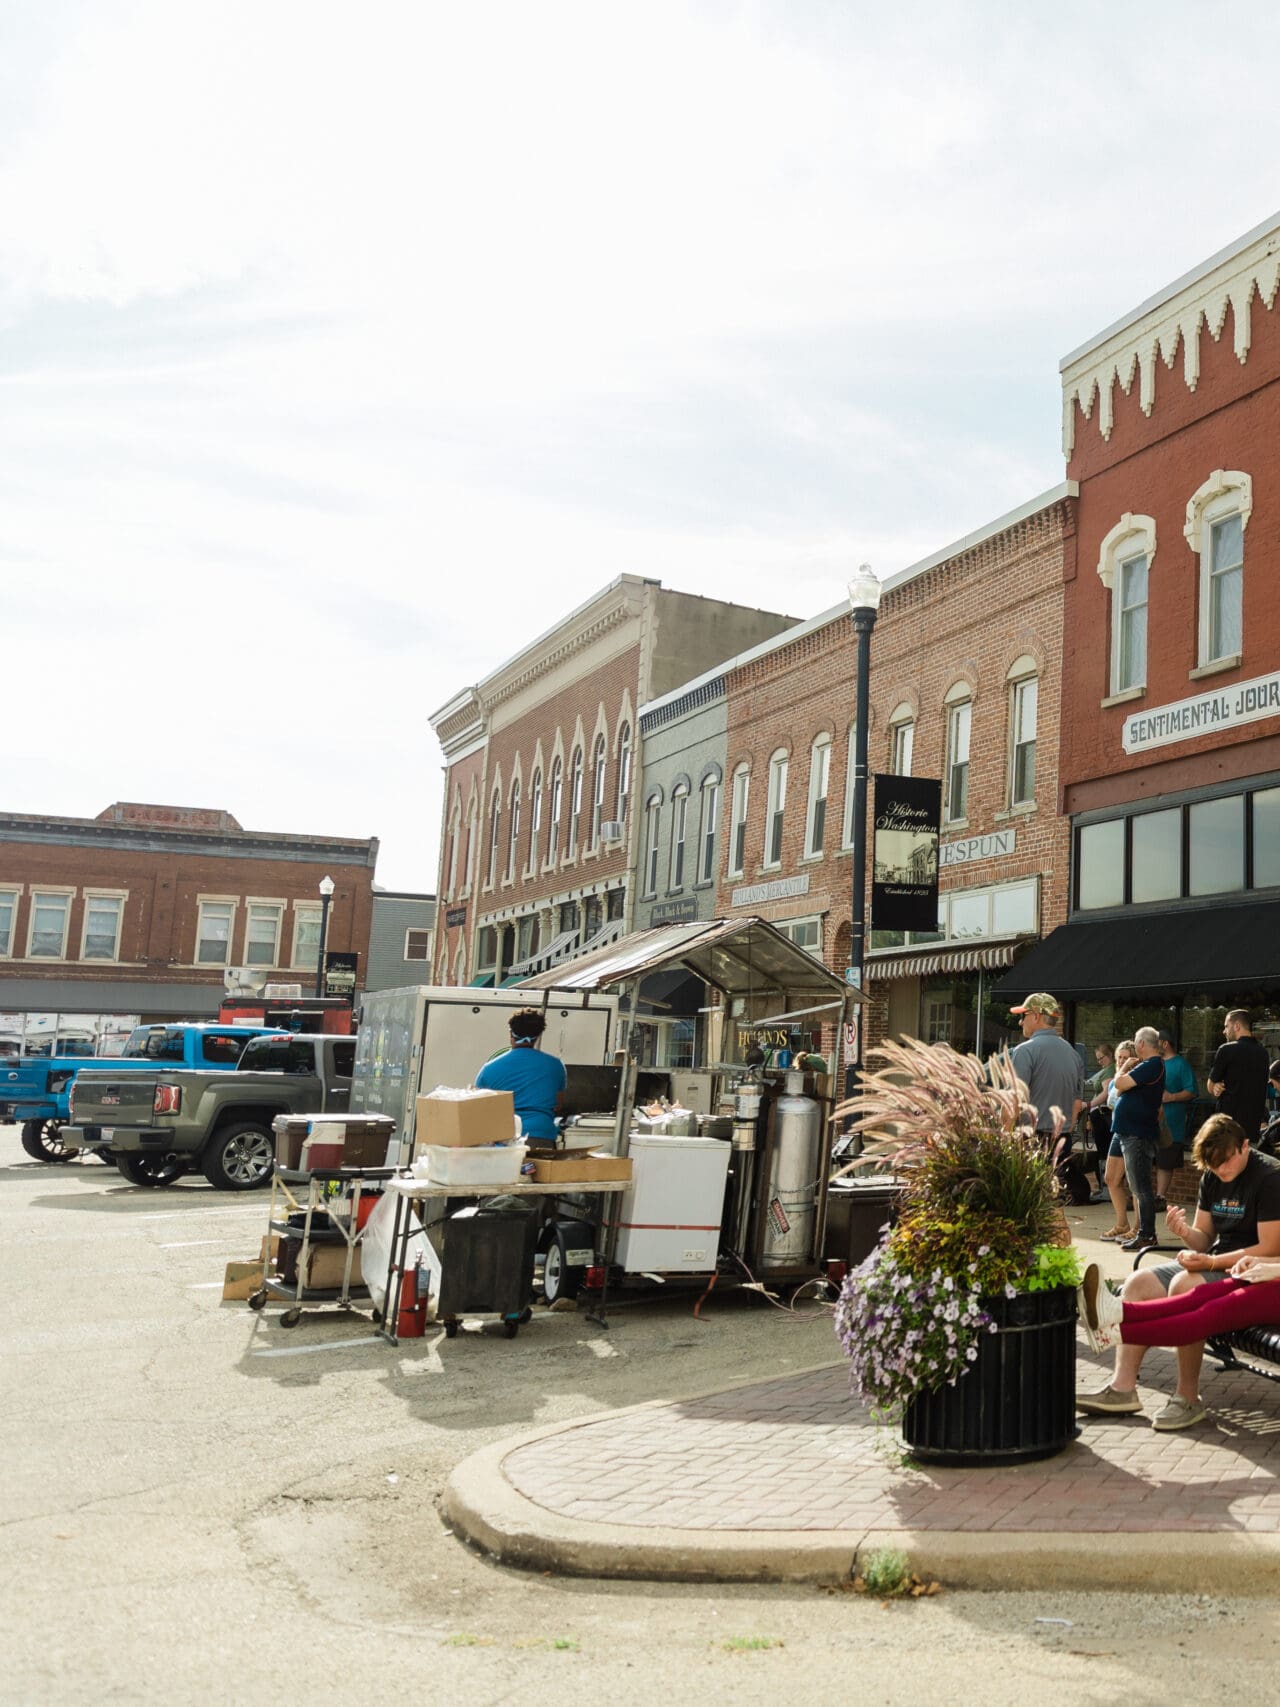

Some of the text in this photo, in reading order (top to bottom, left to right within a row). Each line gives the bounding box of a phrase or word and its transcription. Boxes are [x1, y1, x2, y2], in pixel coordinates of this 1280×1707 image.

[1130, 697, 1230, 745] SENTIMENTAL
[885, 800, 929, 818] Historic
[876, 815, 938, 837] Washington
[939, 832, 1009, 865] ESPUN
